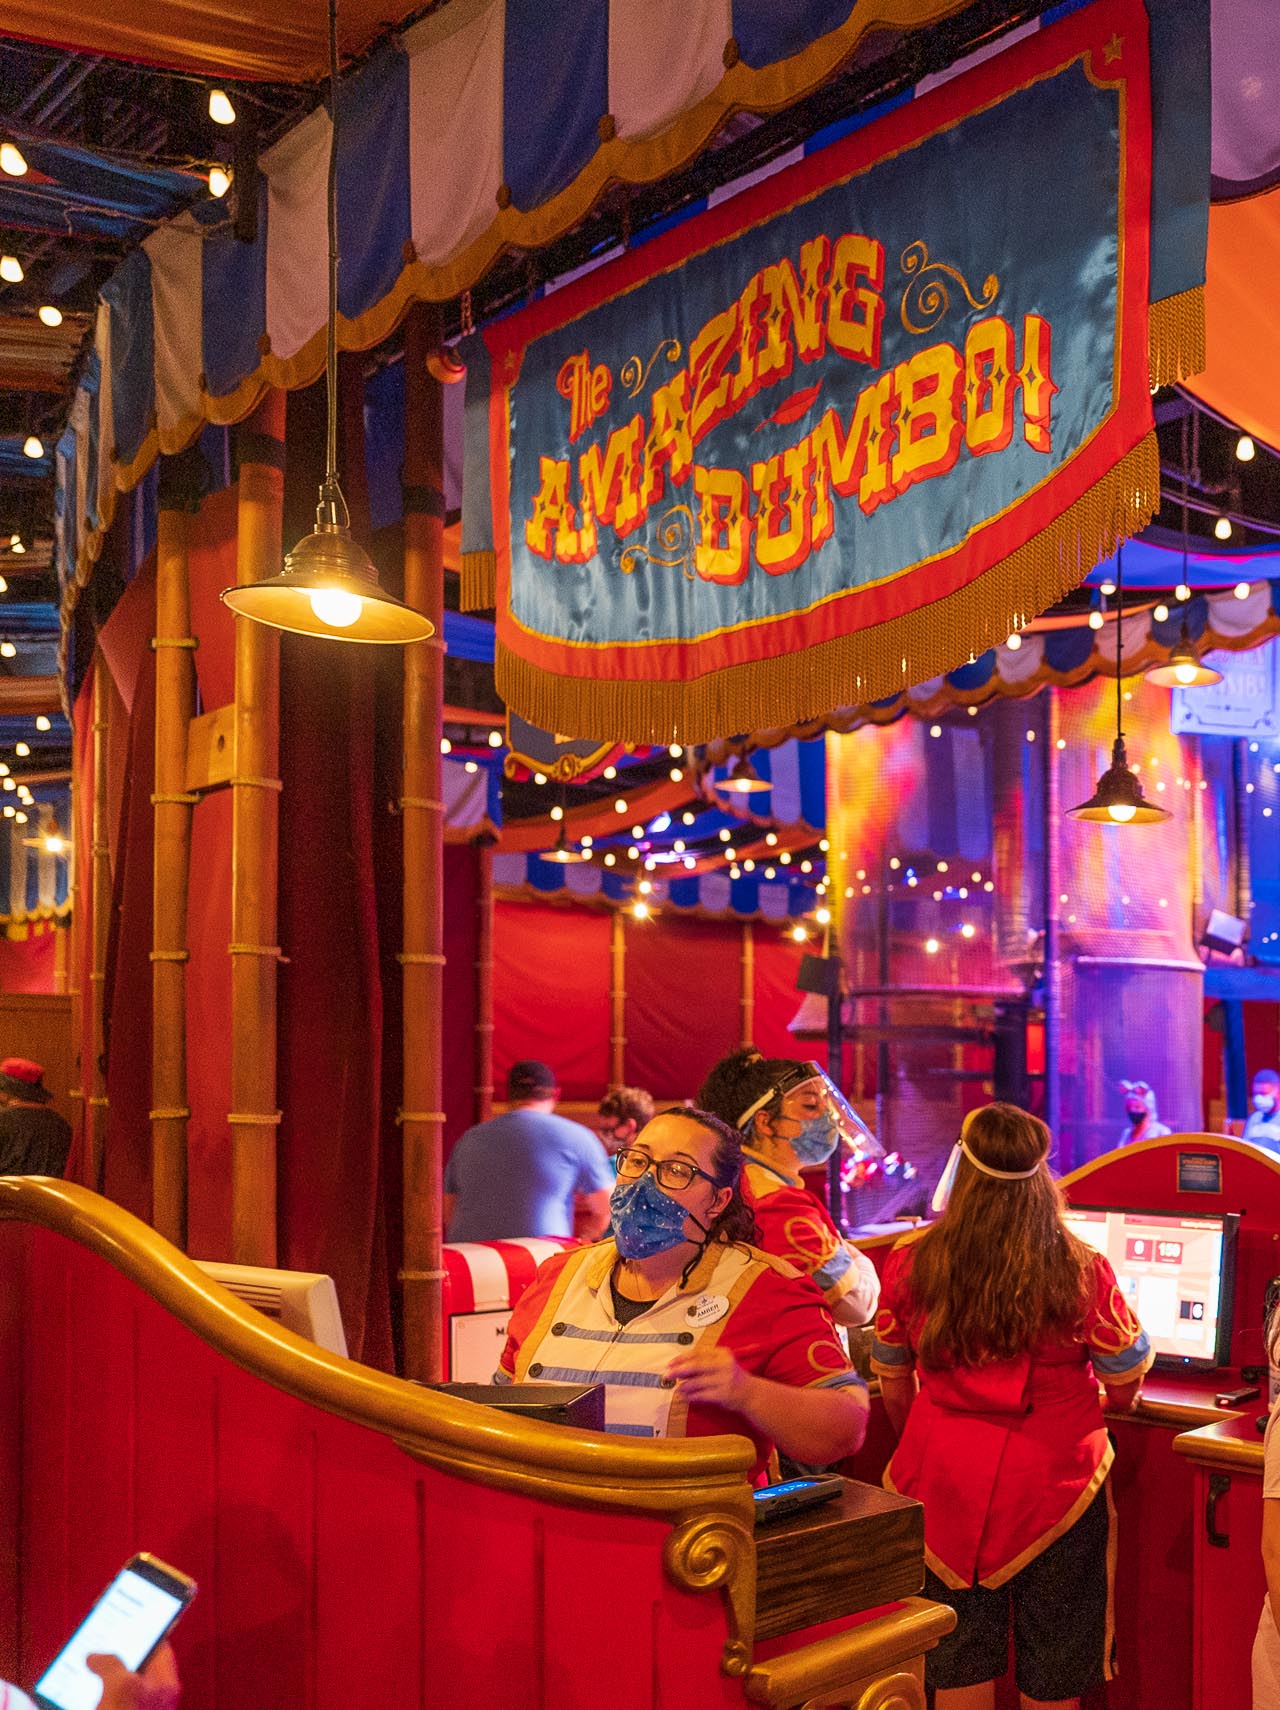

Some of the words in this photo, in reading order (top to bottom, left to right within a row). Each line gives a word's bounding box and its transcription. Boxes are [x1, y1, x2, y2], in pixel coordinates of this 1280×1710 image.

[525, 234, 885, 565] AMAZING
[557, 347, 611, 442] The
[692, 315, 1059, 585] DUMBO!
